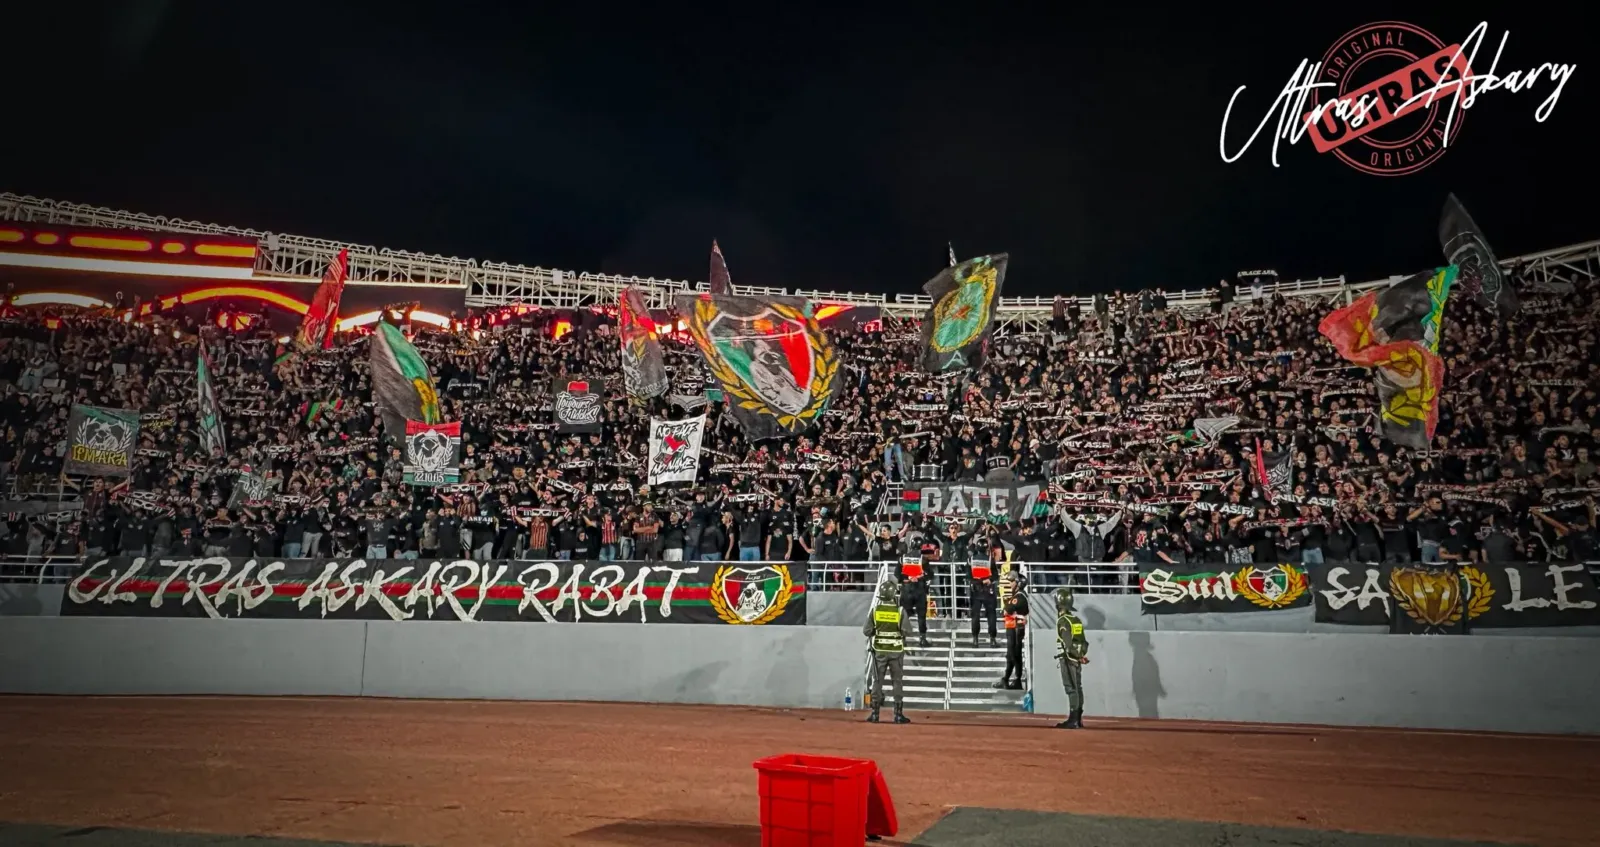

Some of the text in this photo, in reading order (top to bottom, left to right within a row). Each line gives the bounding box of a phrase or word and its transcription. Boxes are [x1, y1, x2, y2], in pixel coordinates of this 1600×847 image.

[920, 484, 1041, 520] GATE 7
[68, 556, 699, 623] ULTRAS ASKARY RABAT
[1141, 568, 1238, 604] Sud
